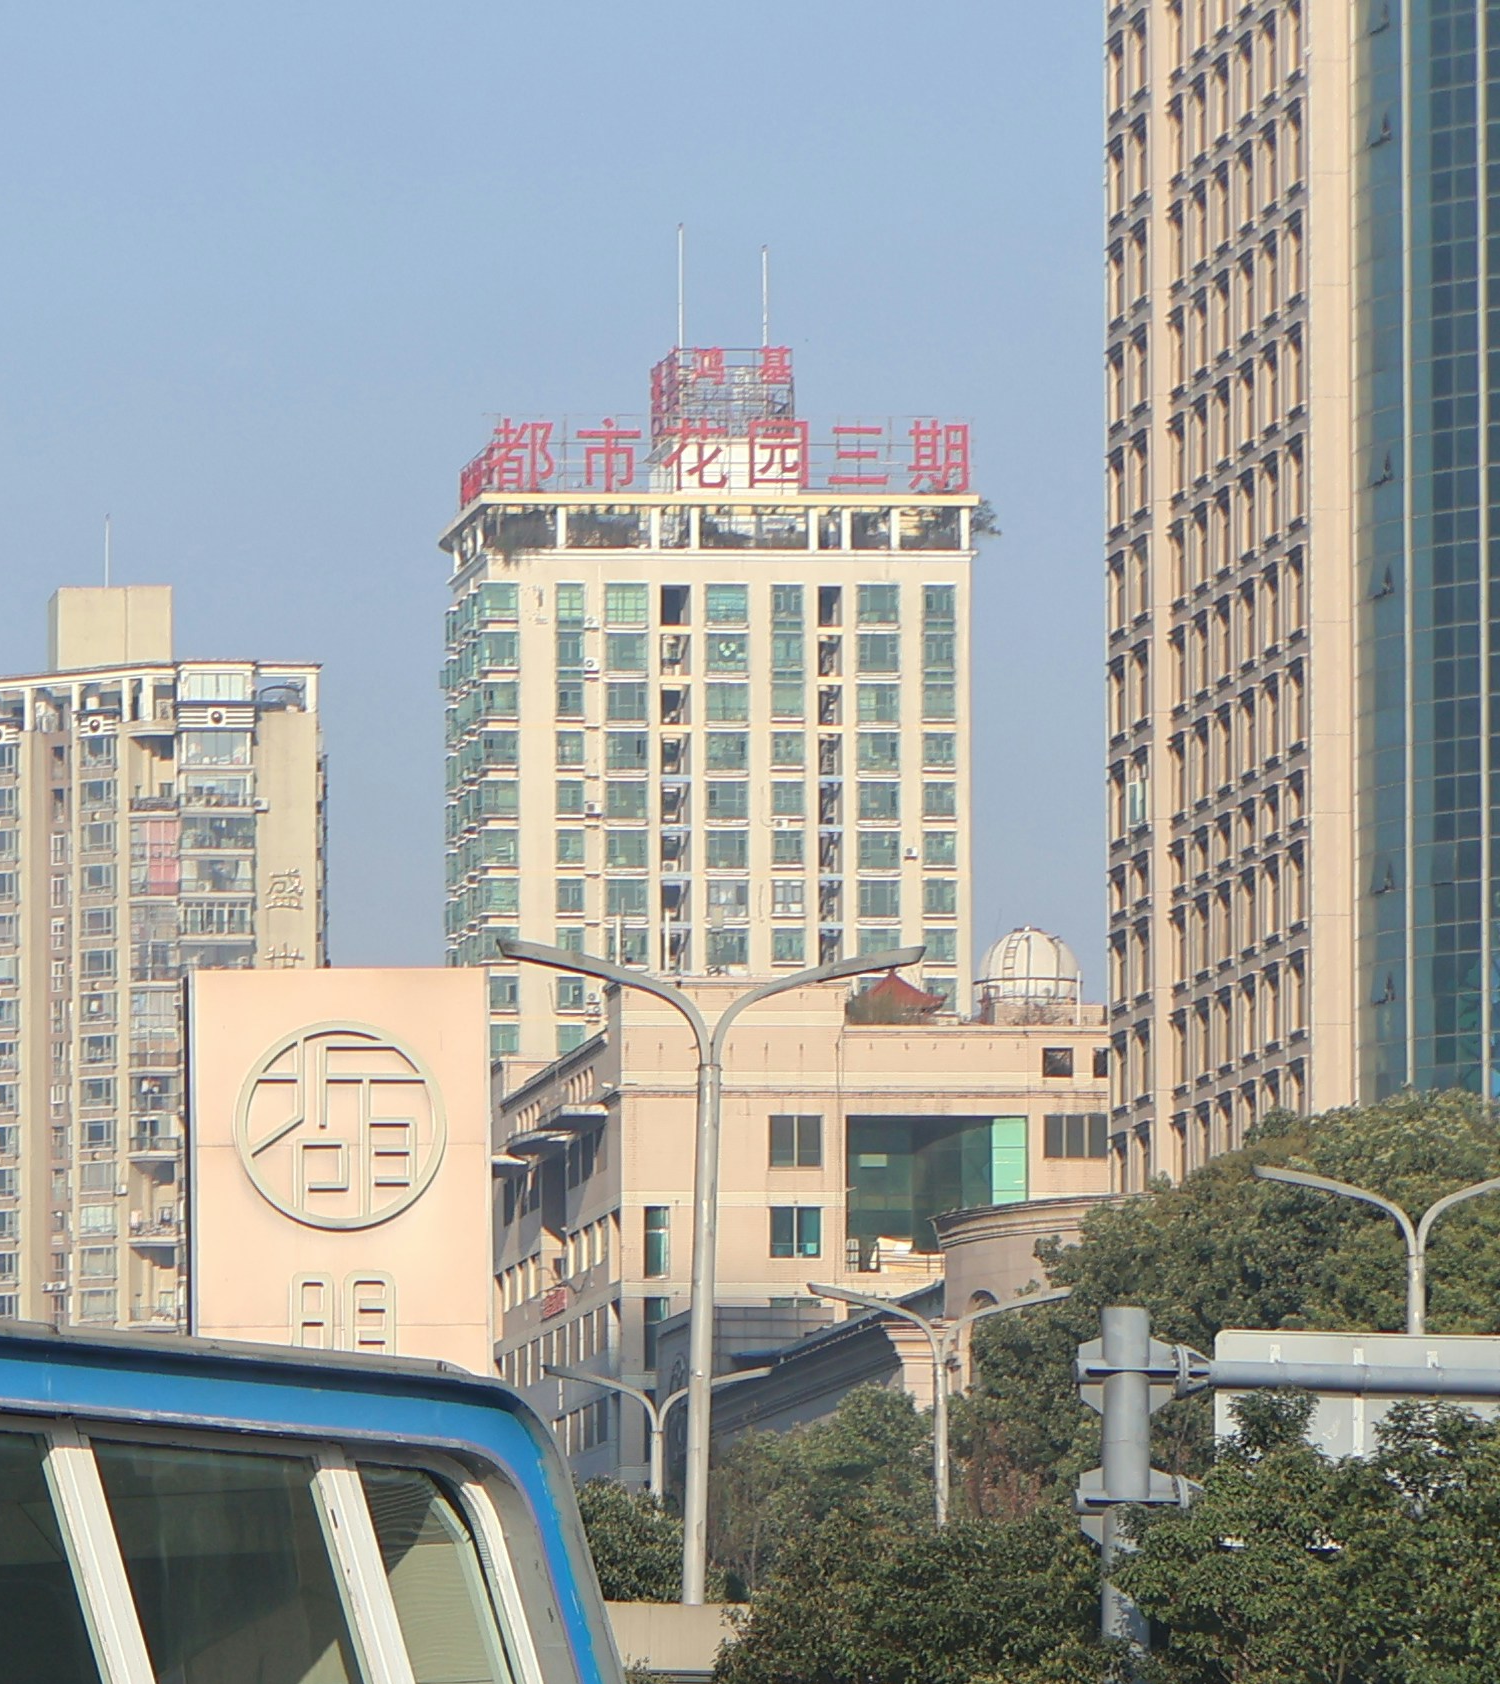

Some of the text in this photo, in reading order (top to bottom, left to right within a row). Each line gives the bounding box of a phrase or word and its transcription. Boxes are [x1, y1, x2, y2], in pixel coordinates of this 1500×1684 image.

[486, 417, 971, 492] 都市花园三期
